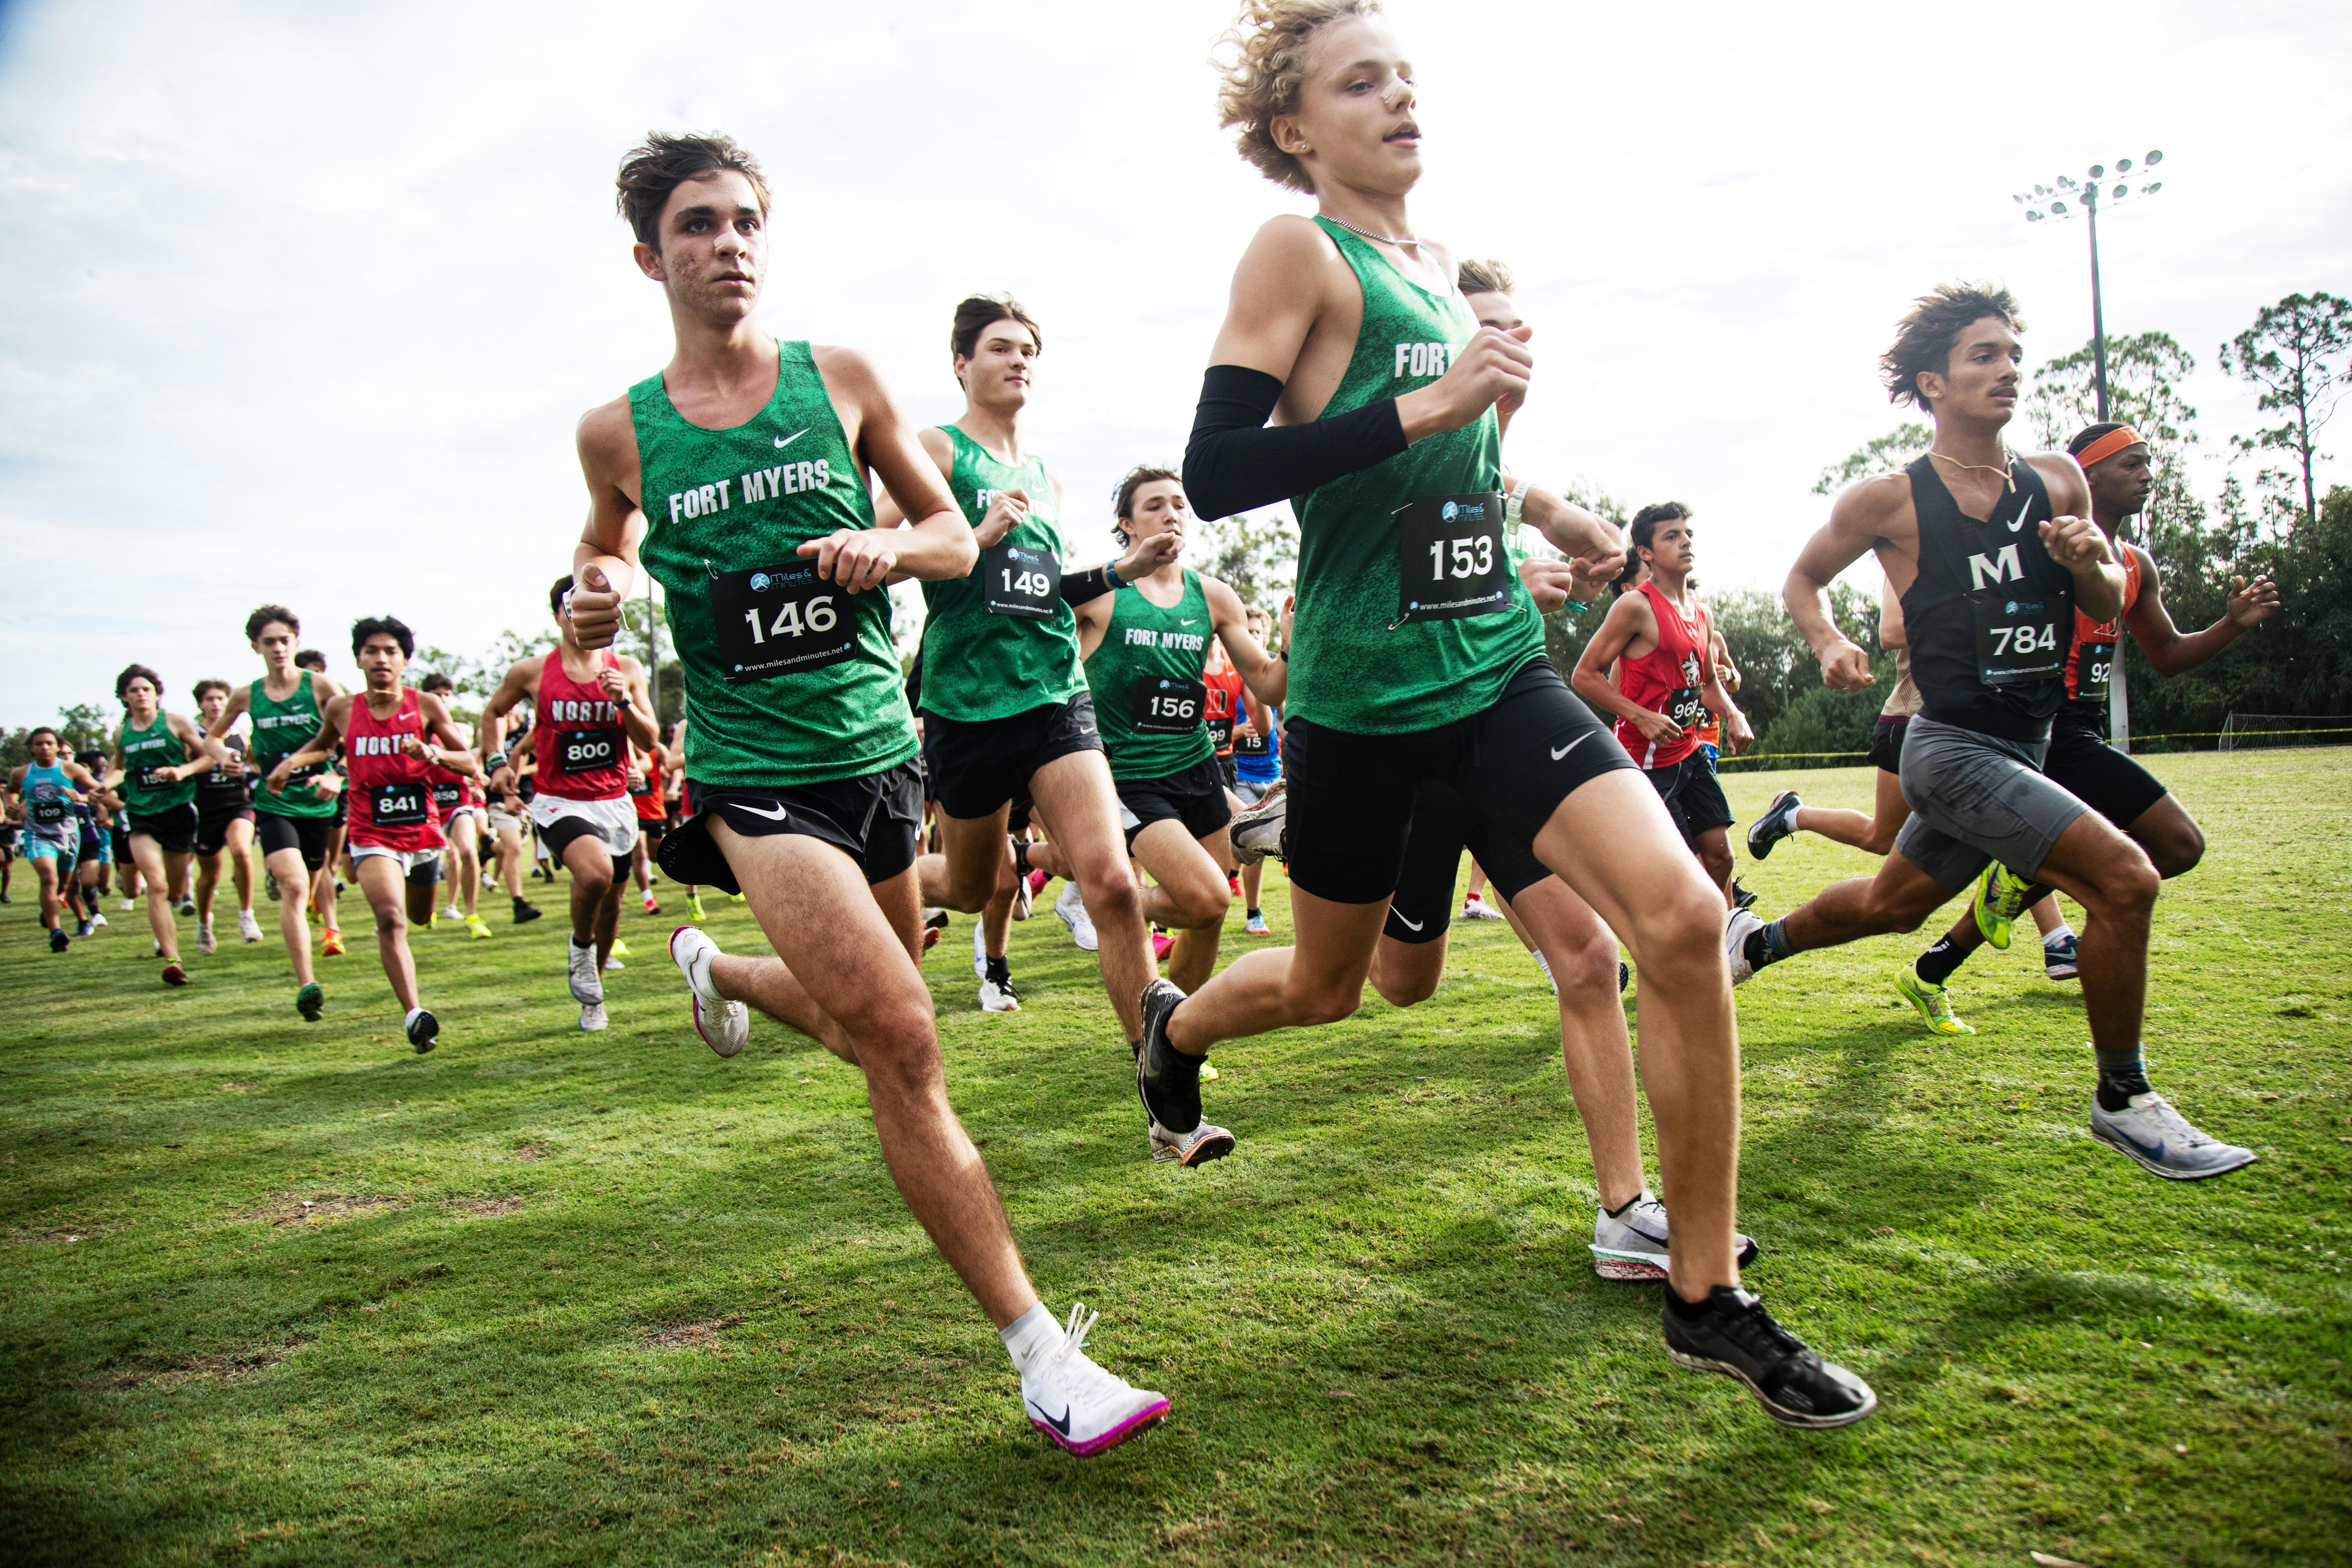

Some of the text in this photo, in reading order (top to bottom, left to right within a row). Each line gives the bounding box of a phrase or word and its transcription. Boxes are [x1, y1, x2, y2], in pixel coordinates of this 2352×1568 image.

[669, 459, 830, 524] FORT MYERS
[1430, 535, 1493, 580] 153
[1967, 544, 2025, 591] M
[1002, 568, 1050, 597] 149
[1420, 594, 1496, 611] www.milesandminutes.net
[745, 596, 837, 644] 146
[1125, 629, 1204, 651] FORT MYERS
[1990, 624, 2057, 656] 784
[744, 646, 843, 671] www.milesandminutes.net
[1151, 696, 1196, 718] 156
[1674, 699, 1698, 719] 969
[567, 742, 610, 761] 800
[39, 808, 61, 816] 109
[379, 795, 417, 813] 841
